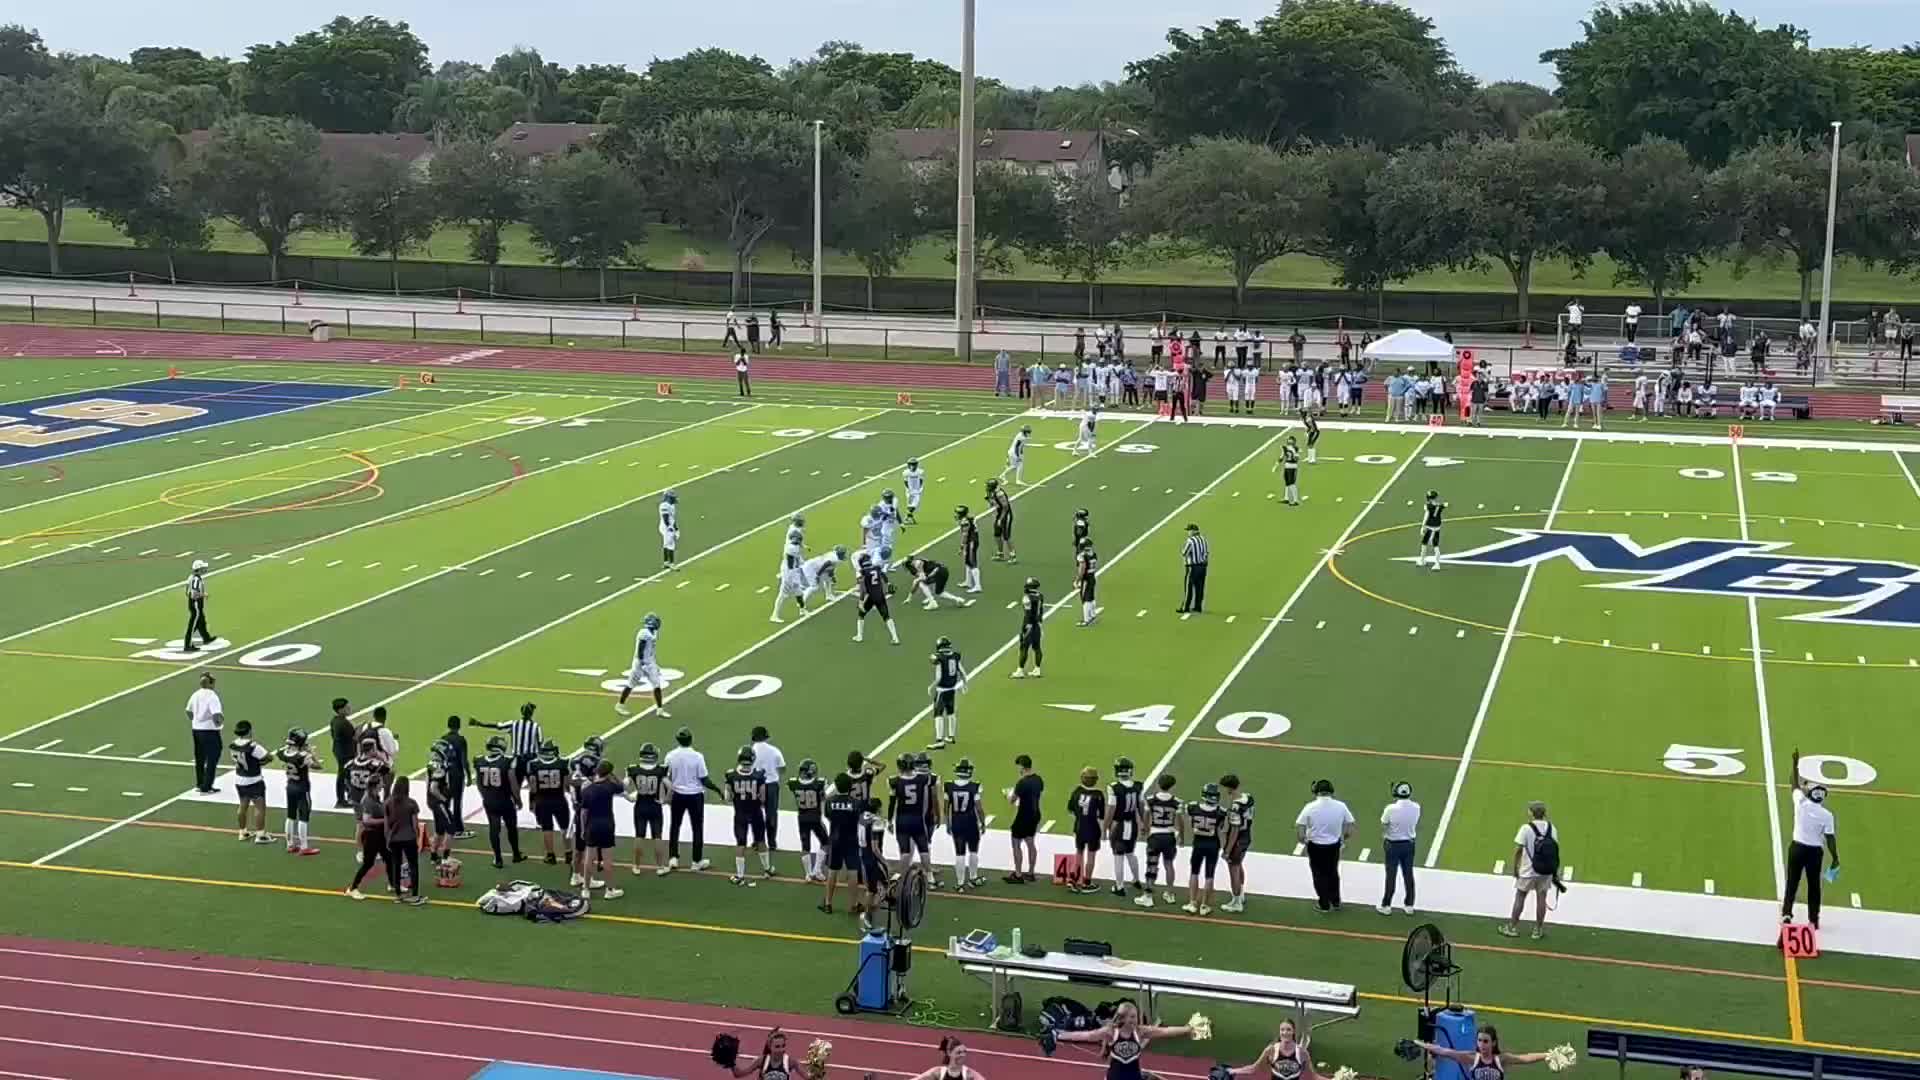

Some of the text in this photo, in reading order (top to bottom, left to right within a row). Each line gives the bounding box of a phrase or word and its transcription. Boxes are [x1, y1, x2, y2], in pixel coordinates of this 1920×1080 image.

[870, 570, 879, 585] 2
[734, 780, 758, 801] 44
[904, 784, 917, 805] 5
[952, 791, 970, 812] 17
[1078, 794, 1092, 816] 4
[1152, 806, 1177, 825] 23
[1193, 816, 1216, 836] 25
[1788, 927, 1813, 955] 50
